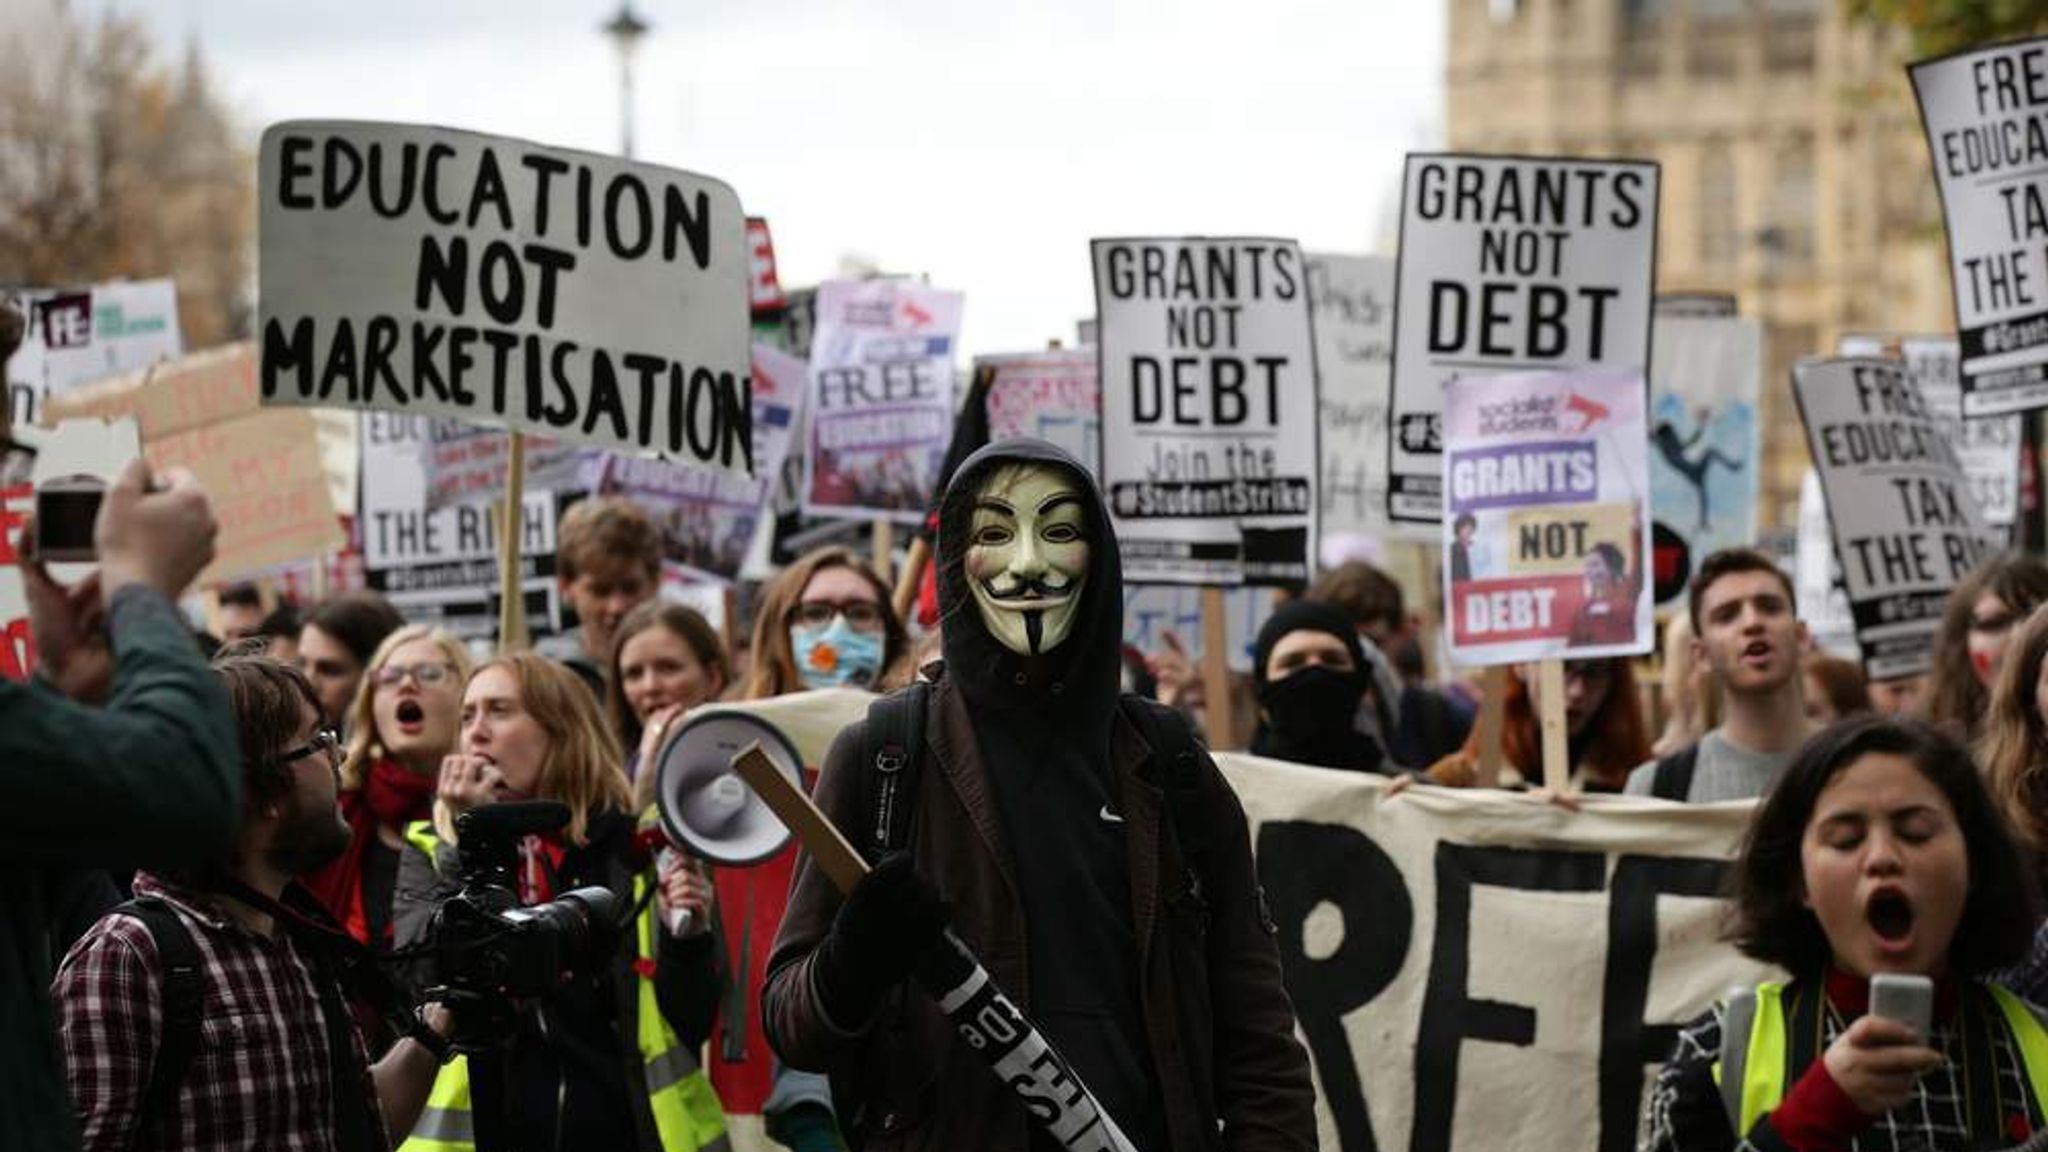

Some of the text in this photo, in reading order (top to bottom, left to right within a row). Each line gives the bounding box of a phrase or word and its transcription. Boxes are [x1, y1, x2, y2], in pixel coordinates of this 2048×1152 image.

[1942, 113, 2048, 177] EDUCA
[279, 137, 711, 270] EDUCATION
[1417, 164, 1643, 229] GRANTS
[1108, 246, 1296, 300] GRANTS
[1480, 229, 1570, 277] NOT
[415, 235, 576, 329] NOT
[1963, 251, 2034, 313] THE
[1168, 305, 1243, 349] NOT
[1428, 280, 1619, 361] DEBT
[261, 316, 753, 477] MARKETISATION
[818, 364, 937, 406] FREE
[1130, 357, 1288, 426] DEBT
[1147, 443, 1276, 481] Join the
[1453, 452, 1595, 500] GRANTS
[1117, 482, 1307, 515] #StudentStrike
[1890, 478, 1968, 527] TAX
[374, 502, 544, 558] THE RIH
[1520, 521, 1590, 561] NOT
[1851, 534, 1936, 587] THE
[1465, 587, 1556, 635] DEBT
